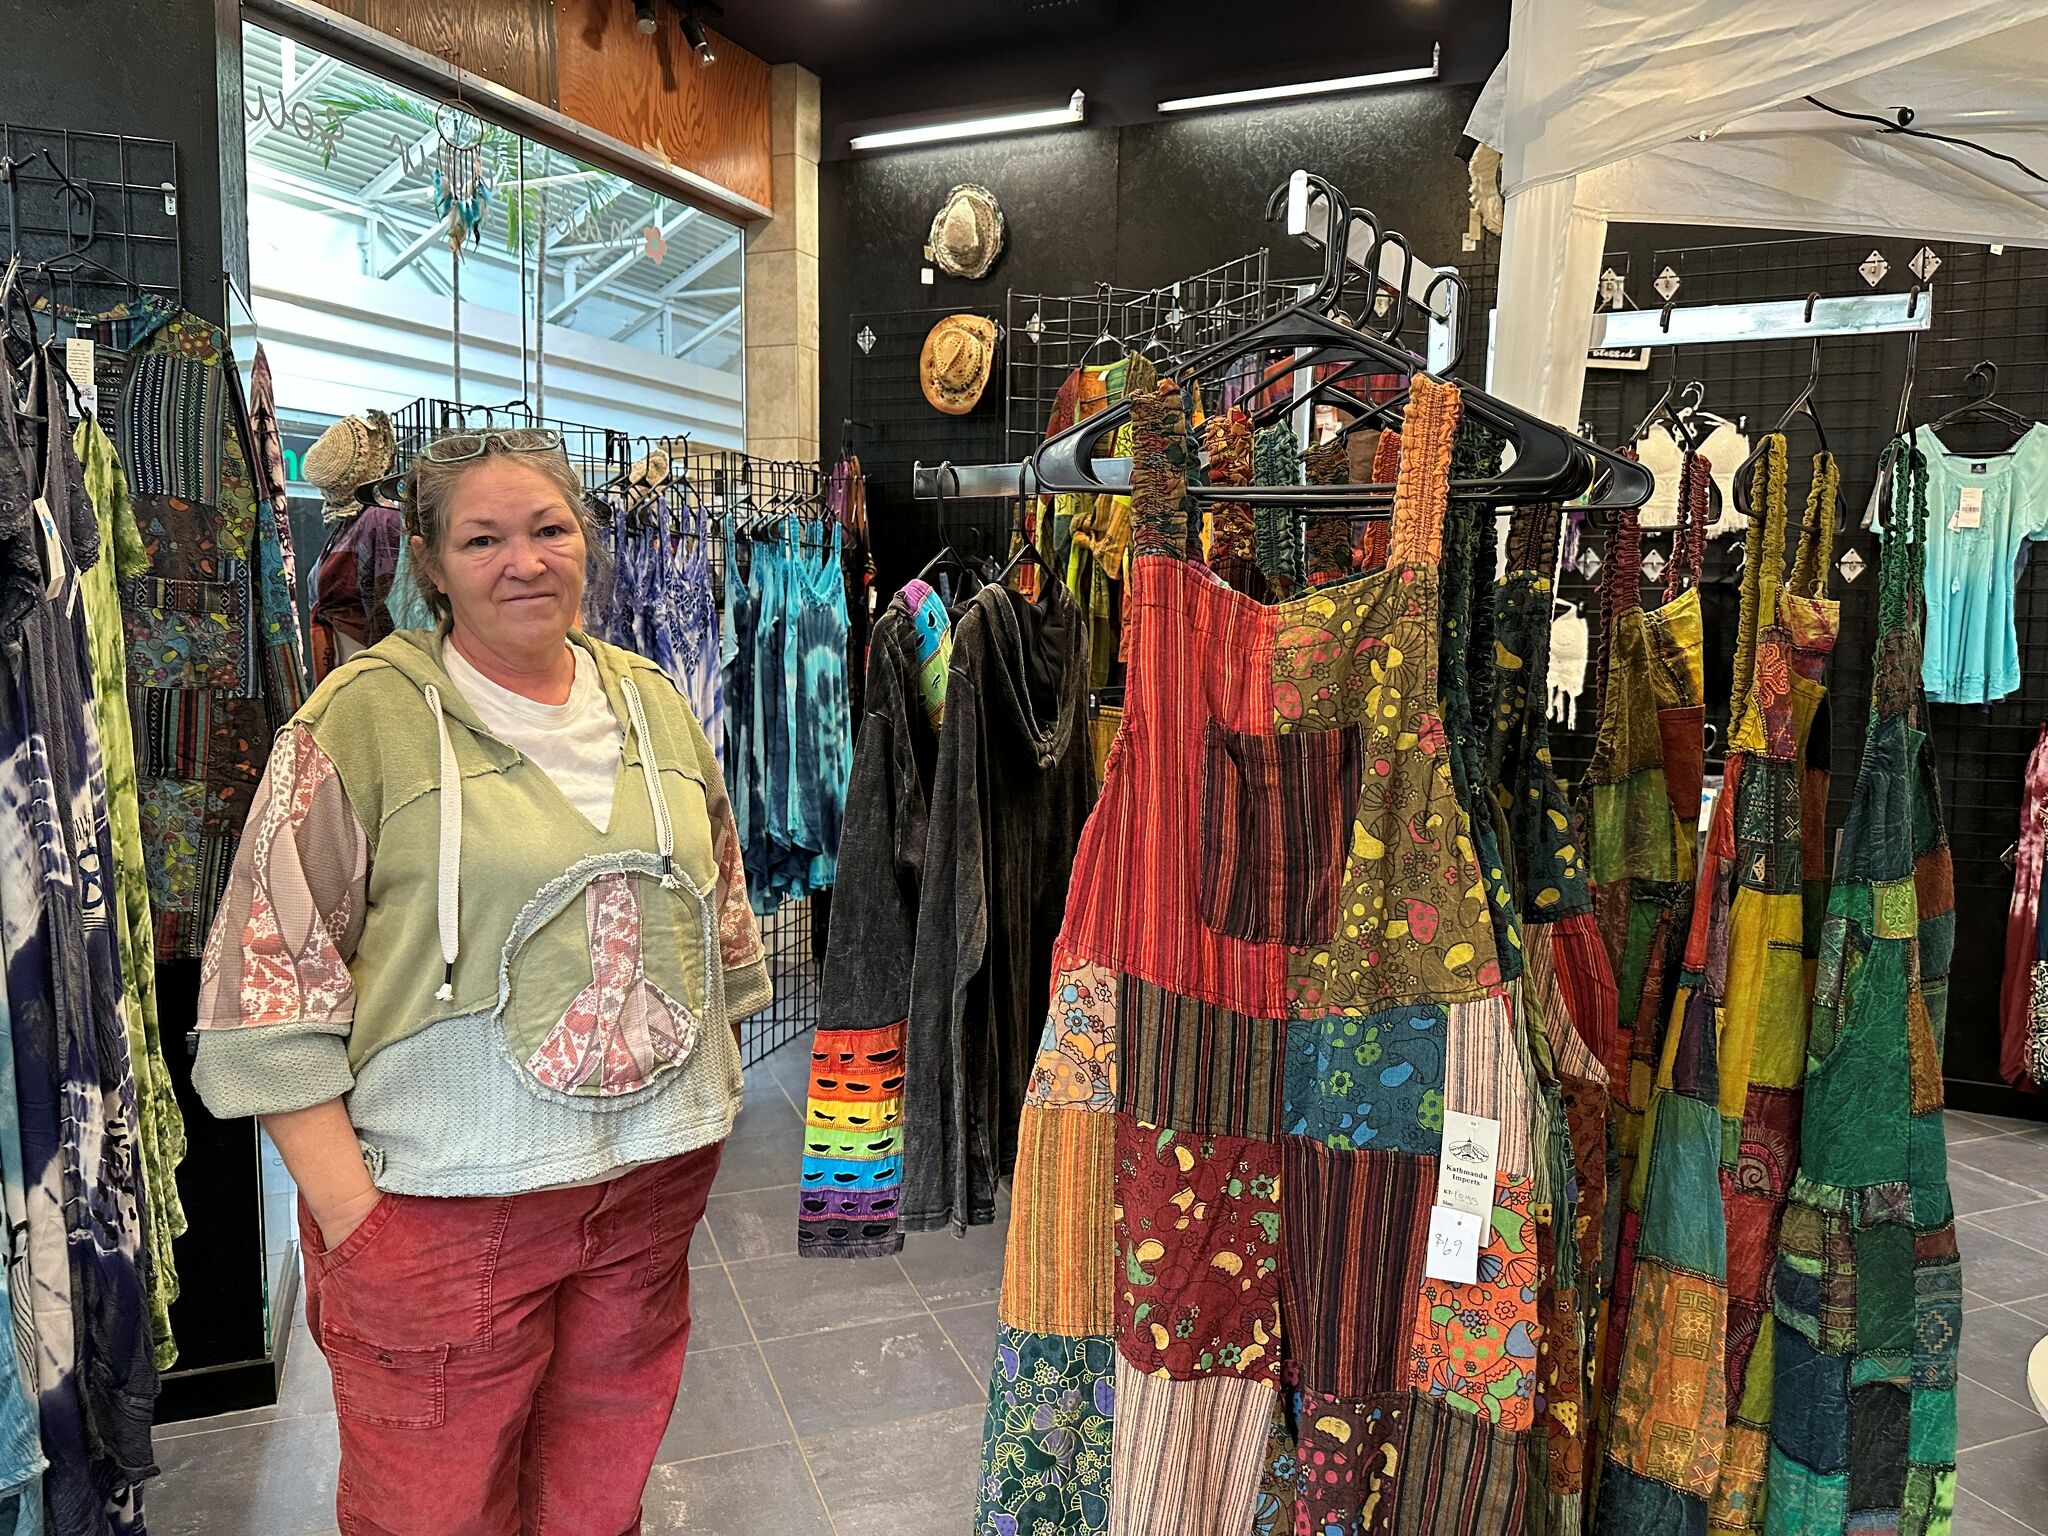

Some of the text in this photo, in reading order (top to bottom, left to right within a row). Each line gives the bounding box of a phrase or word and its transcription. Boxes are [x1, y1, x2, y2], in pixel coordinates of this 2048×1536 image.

[1446, 1164, 1488, 1180] Kathmandu
[1452, 1174, 1480, 1186] Imports
[1434, 1233, 1463, 1257] $69
